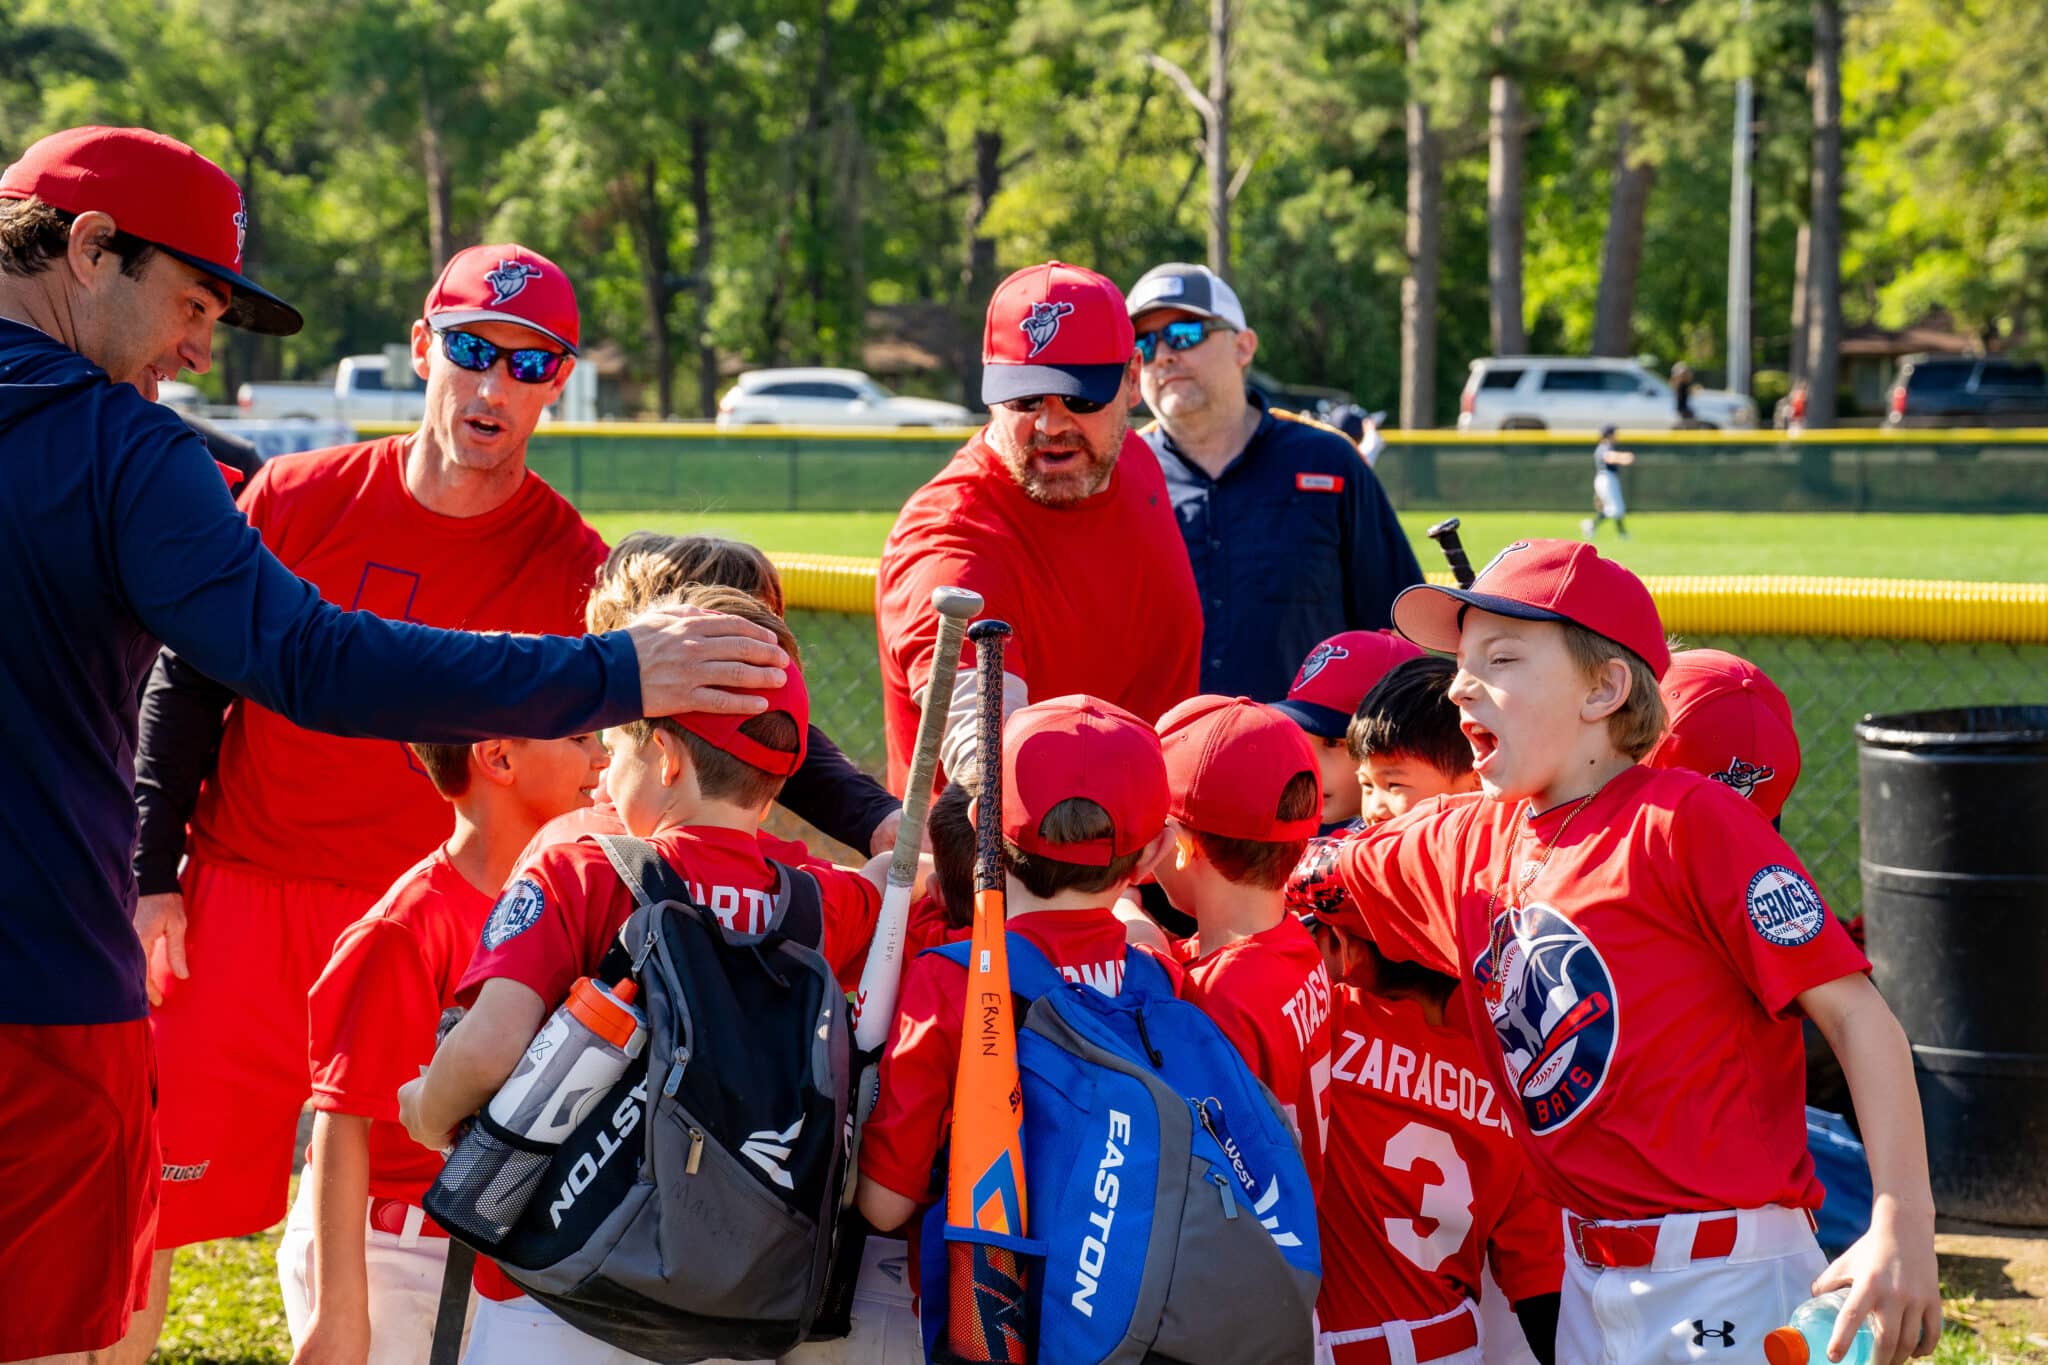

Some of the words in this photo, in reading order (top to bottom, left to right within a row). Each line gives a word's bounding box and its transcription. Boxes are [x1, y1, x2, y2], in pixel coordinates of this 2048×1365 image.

[1753, 881, 1817, 930] SBMSA
[981, 992, 1002, 1057] ERWIN
[1536, 1065, 1593, 1124] BATS
[549, 1072, 648, 1230] ASTON
[1383, 1121, 1474, 1273] 3
[1071, 1109, 1131, 1318] EASTON
